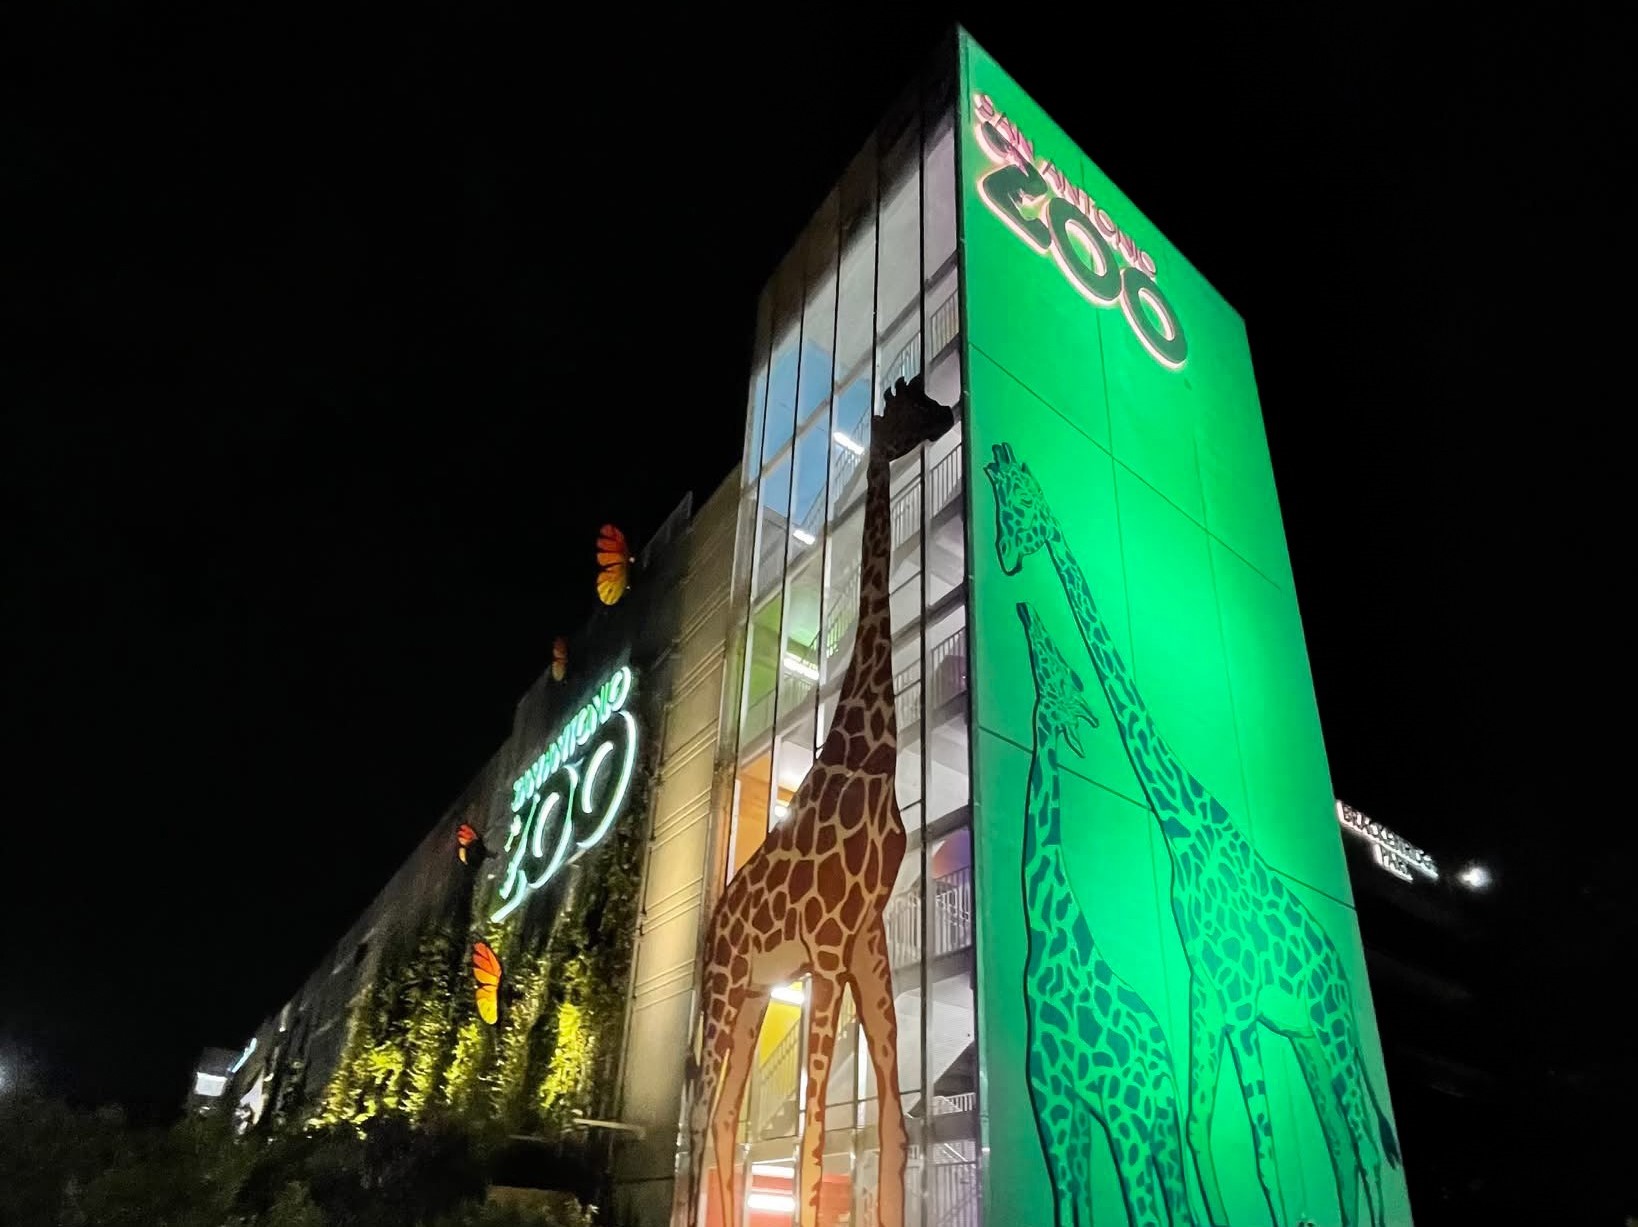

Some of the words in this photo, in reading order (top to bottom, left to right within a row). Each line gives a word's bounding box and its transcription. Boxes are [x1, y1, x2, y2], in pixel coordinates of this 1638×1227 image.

[974, 93, 1034, 166] SAN
[1039, 159, 1157, 279] ANTONIO
[975, 118, 1188, 368] ZOO
